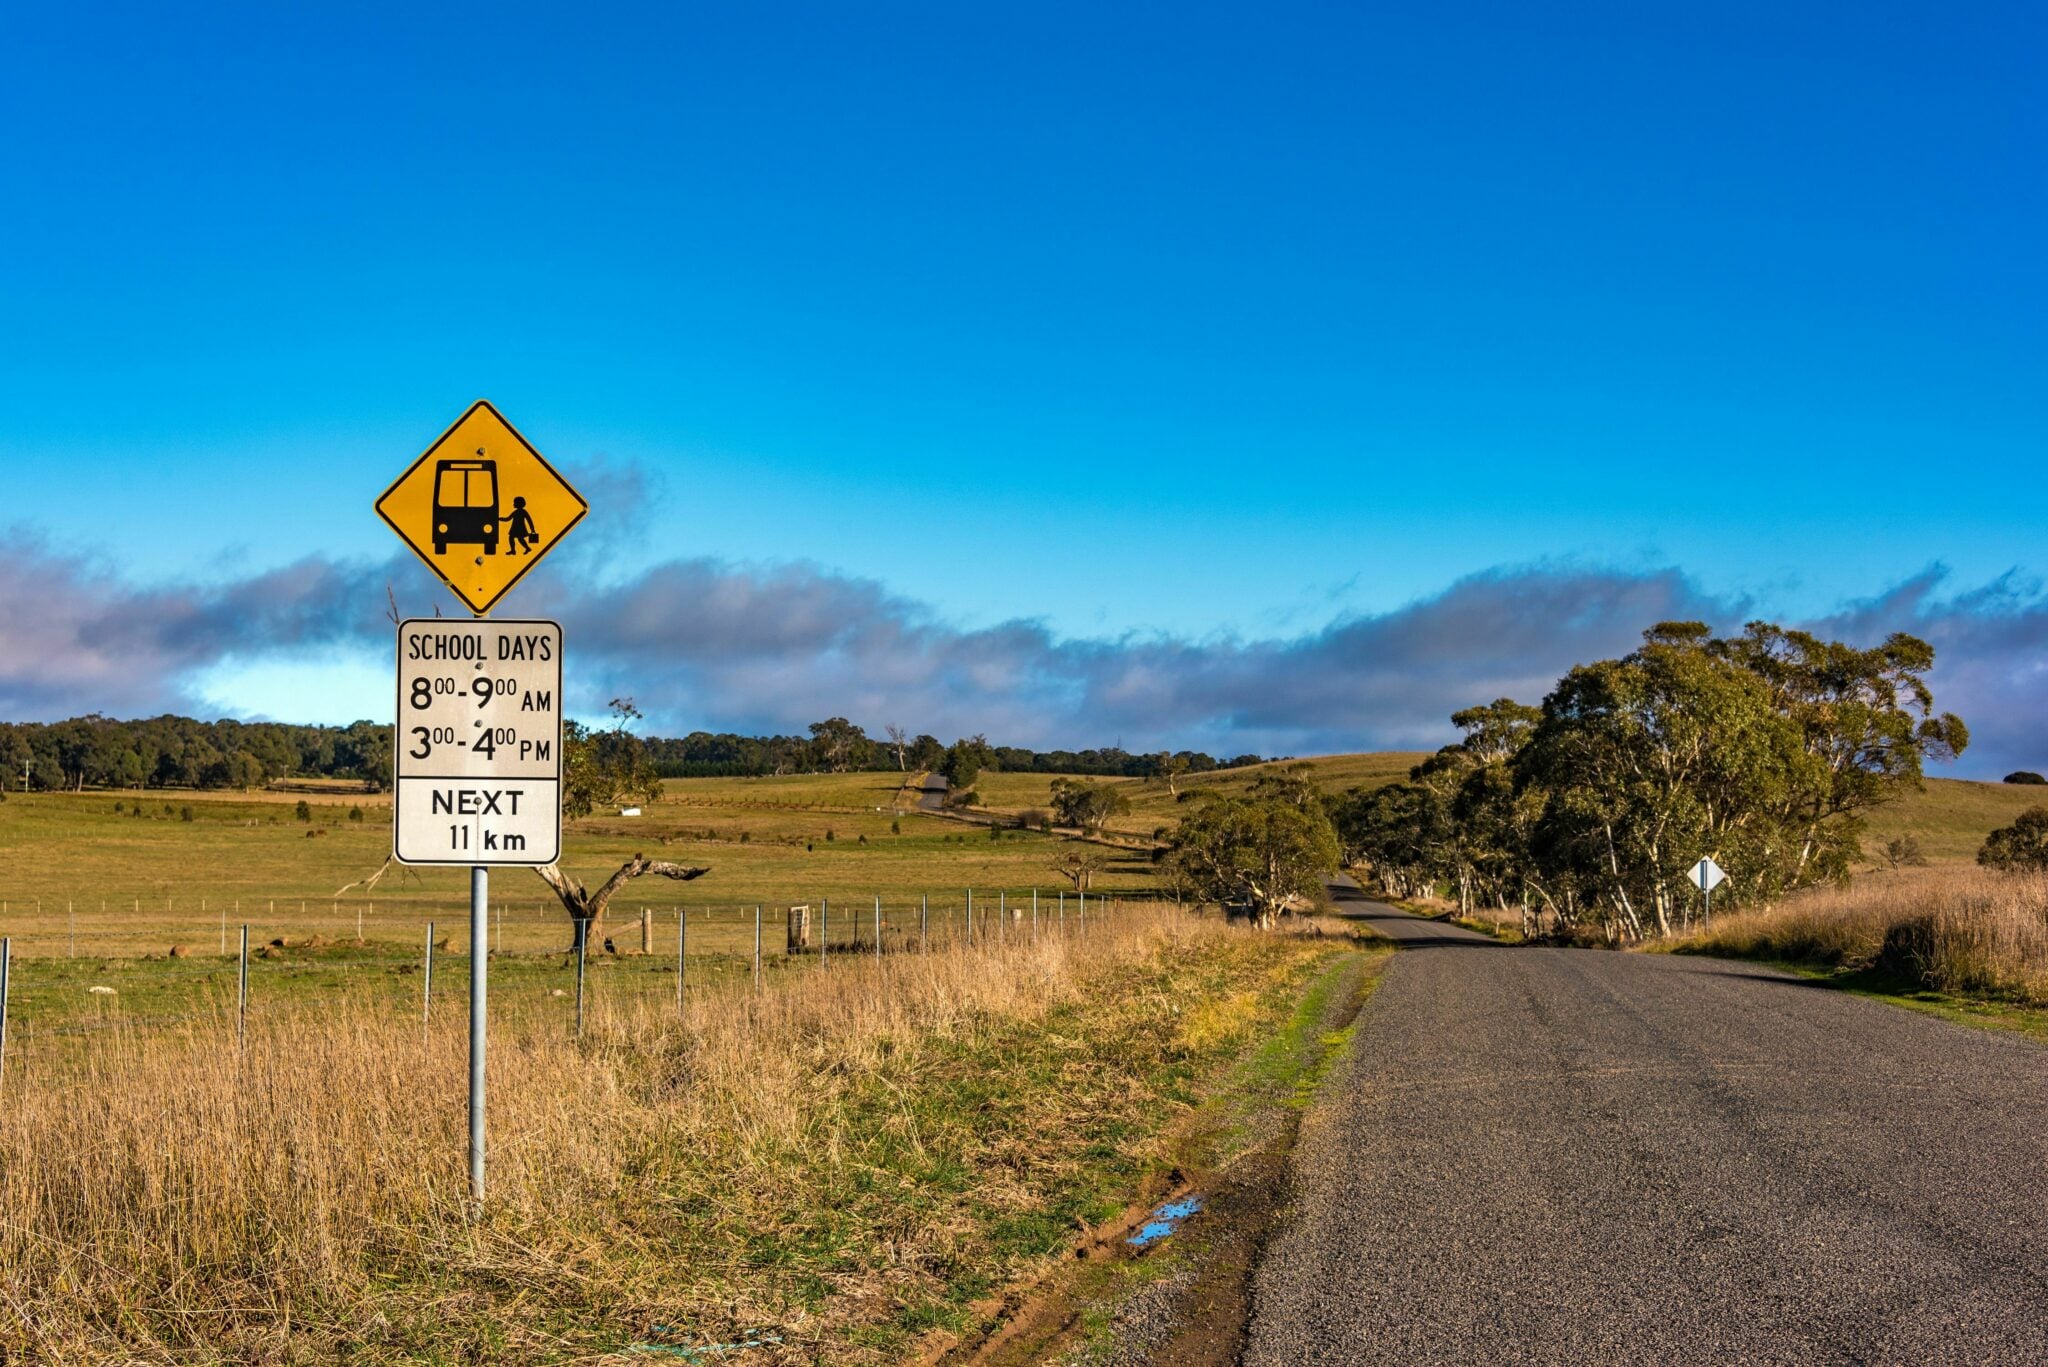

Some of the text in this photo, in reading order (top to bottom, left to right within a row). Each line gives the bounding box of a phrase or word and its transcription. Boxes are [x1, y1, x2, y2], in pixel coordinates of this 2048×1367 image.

[409, 634, 551, 661] SCHOOL DAYS
[521, 690, 551, 712] AM
[520, 740, 550, 762] PM
[432, 789, 524, 816] NEXT
[450, 825, 526, 850] 11 km
